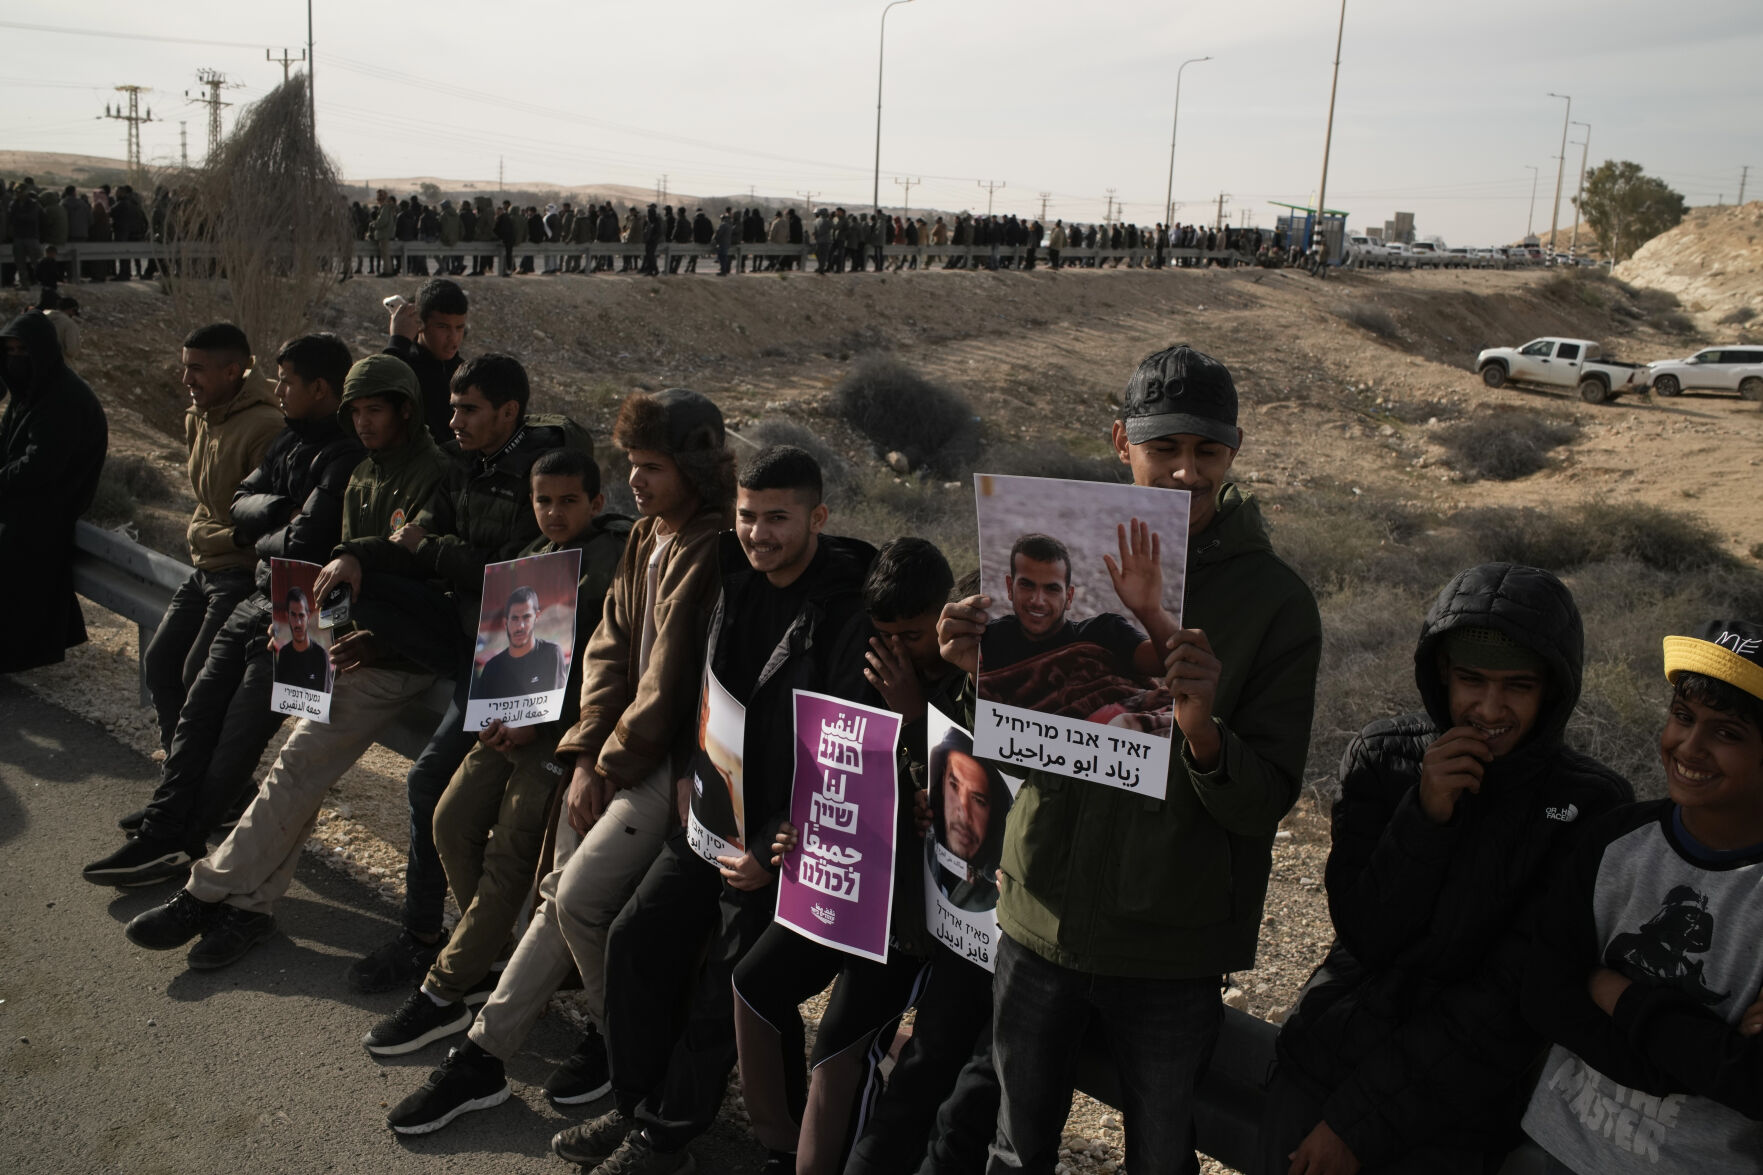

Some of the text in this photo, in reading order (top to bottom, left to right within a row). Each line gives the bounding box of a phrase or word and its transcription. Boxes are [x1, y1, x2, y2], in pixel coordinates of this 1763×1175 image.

[488, 695, 548, 711] גמעה דנפירי
[992, 708, 1151, 760] זאיד אבו מריחיל
[819, 736, 861, 769] הנגב
[998, 737, 1140, 788] زياد ابو مراحيل
[822, 769, 847, 803] لنا
[813, 799, 854, 828] שייך
[802, 860, 857, 896] לכולנו
[966, 923, 990, 945] פאיז
[966, 942, 989, 963] فايز
[1548, 1057, 1667, 1164] MASTER
